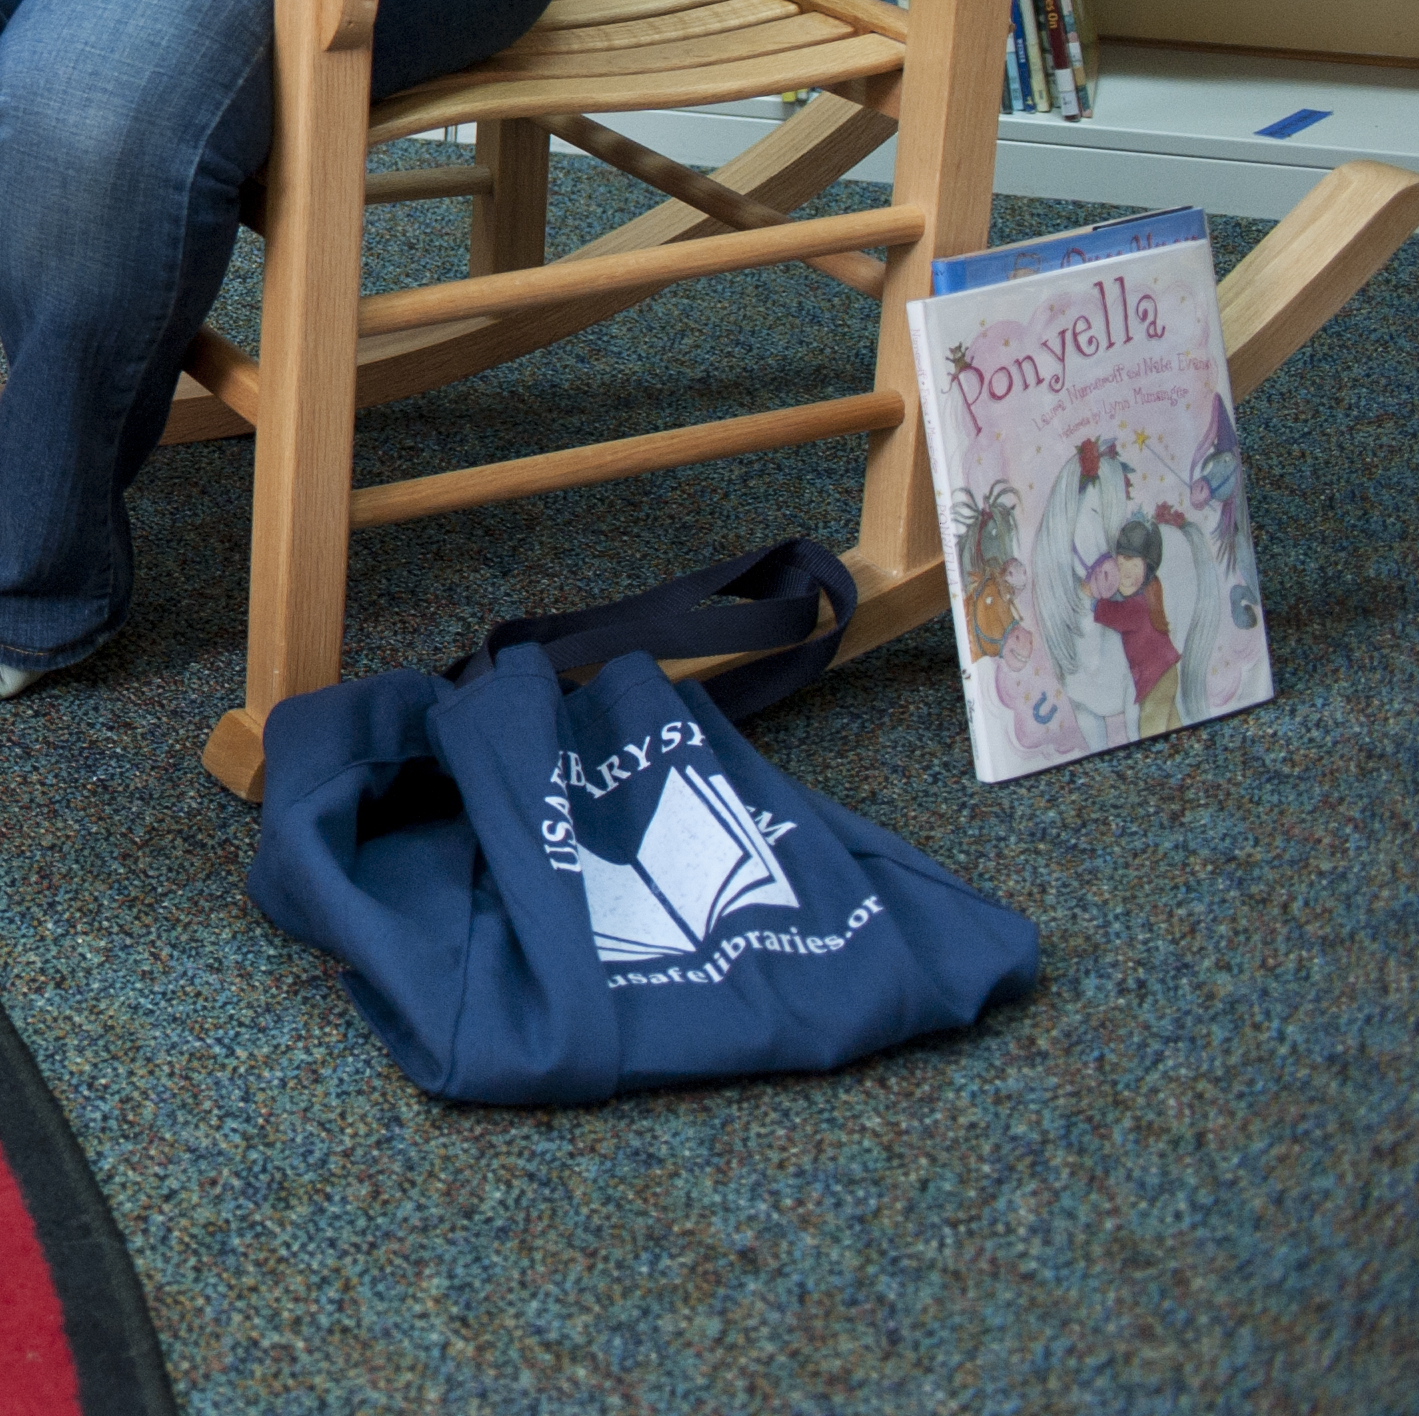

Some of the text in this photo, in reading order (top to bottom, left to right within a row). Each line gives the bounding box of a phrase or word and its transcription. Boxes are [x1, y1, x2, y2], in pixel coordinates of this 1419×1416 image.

[1047, 13, 1058, 29] On
[952, 276, 1166, 435] Ponyella
[1033, 400, 1067, 431] Laura
[1067, 366, 1124, 404] Numeroff
[1144, 357, 1173, 378] Nate
[1177, 353, 1212, 371] Evans
[1103, 396, 1130, 419] Lynn
[936, 504, 958, 585] PONYELLA
